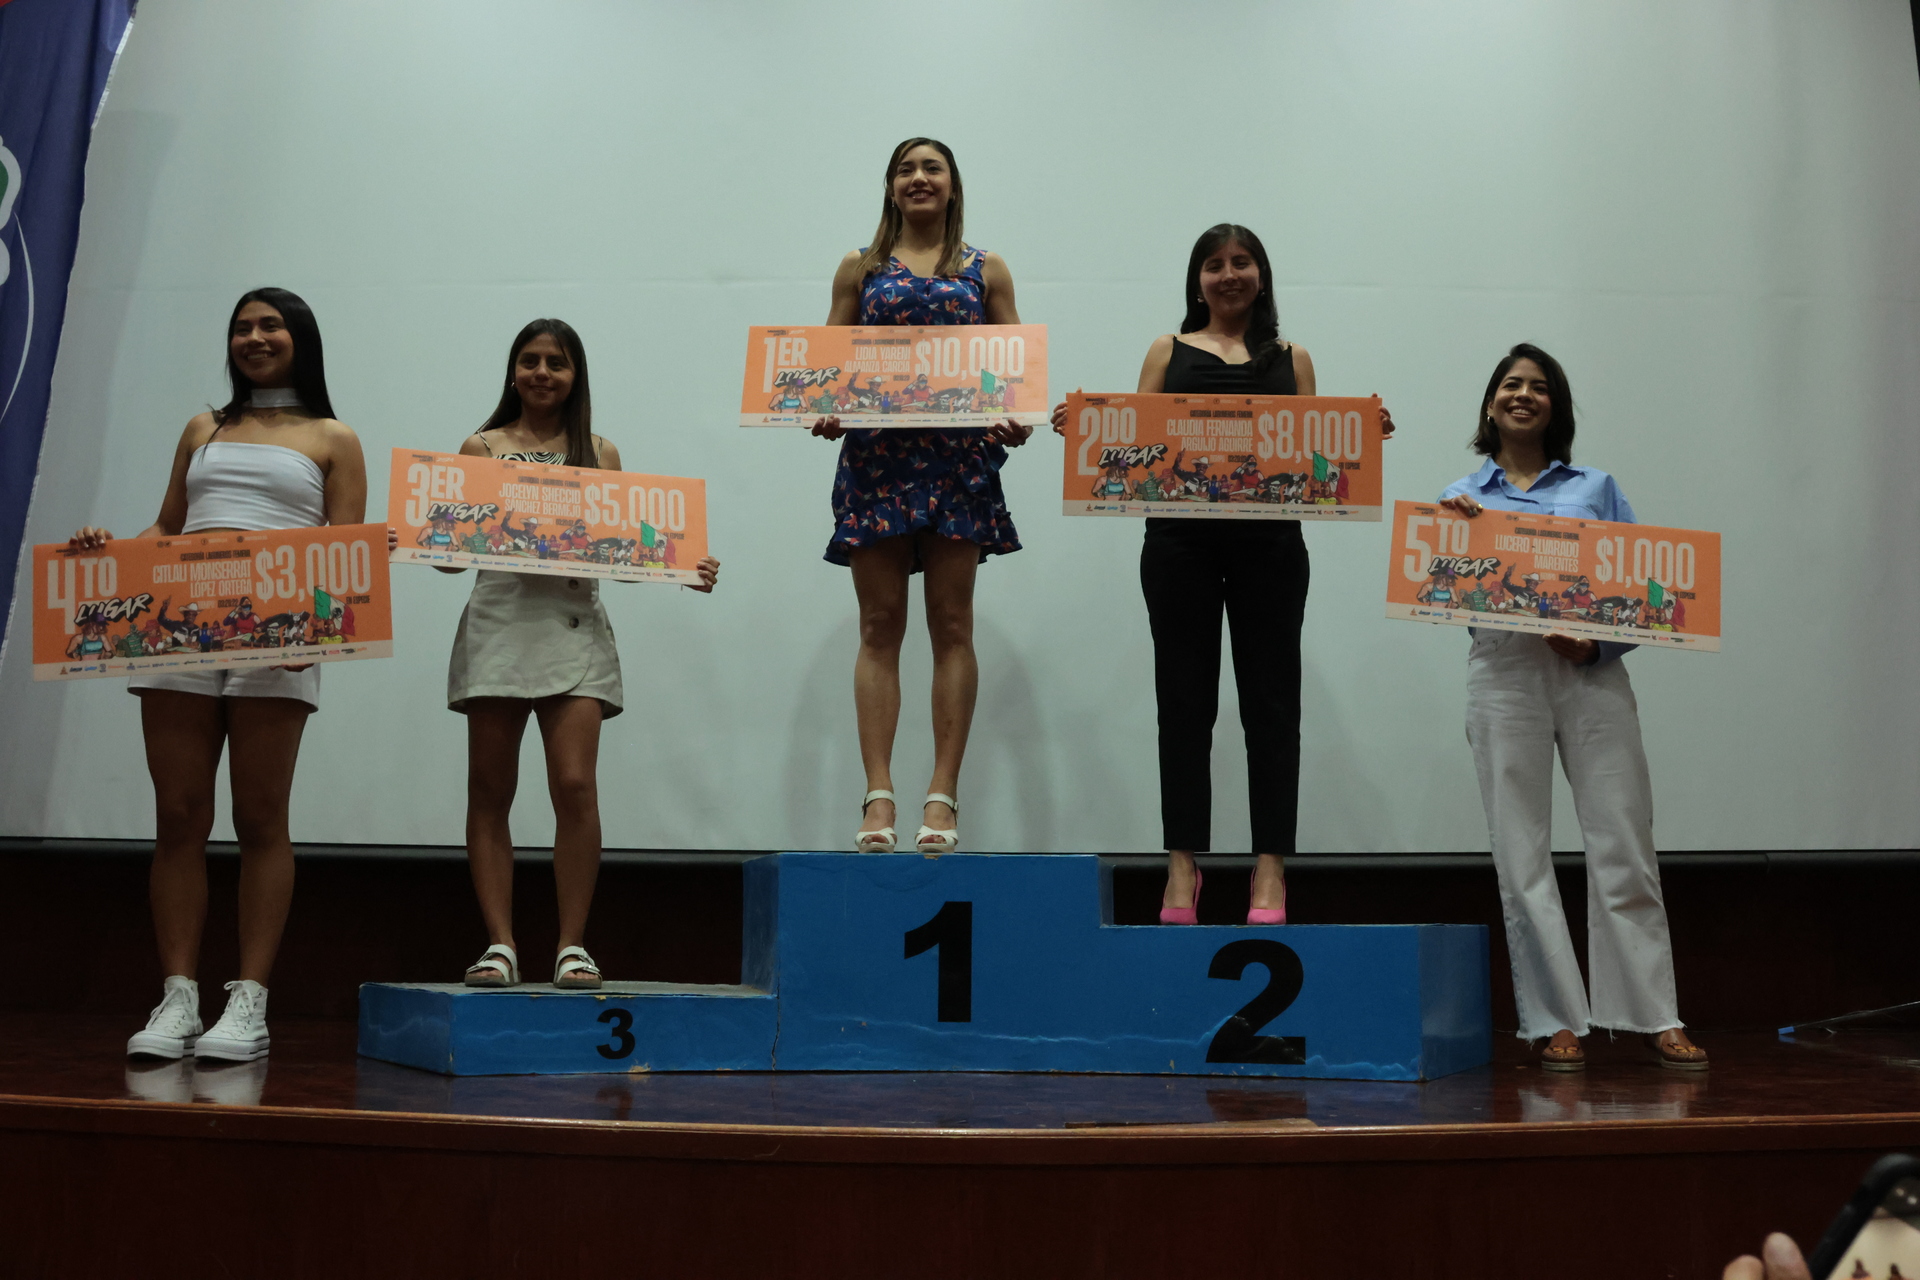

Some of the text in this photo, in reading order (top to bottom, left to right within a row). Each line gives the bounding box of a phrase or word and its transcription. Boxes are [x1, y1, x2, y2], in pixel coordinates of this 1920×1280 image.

[763, 337, 808, 393] 1ER
[855, 346, 911, 360] LIDIA YARENI
[915, 336, 1025, 380] $10,000
[1077, 407, 1137, 476] 2DO
[1167, 419, 1253, 437] CLAUDIA FERNANDA
[1181, 437, 1253, 452] ARGUIJO AGUIRRE
[1257, 410, 1362, 464] $8,000
[405, 463, 465, 527] 3ER
[499, 483, 581, 504] JOCELYN SHECCID
[543, 502, 581, 518] BERMEJO
[584, 483, 685, 532] $5,000
[1403, 515, 1470, 582] 5TO
[1495, 534, 1580, 559] LUCERO ALVARADO
[1534, 555, 1579, 573] MARENTES
[1595, 535, 1695, 590] $1,000
[47, 556, 117, 635] 4TO
[153, 560, 252, 584] CITLALI MONSERRAT
[218, 579, 252, 597] ORTEGA
[255, 540, 371, 604] $3,000
[904, 901, 972, 1022] 1
[1205, 939, 1306, 1065] 2
[596, 1008, 635, 1059] 3
